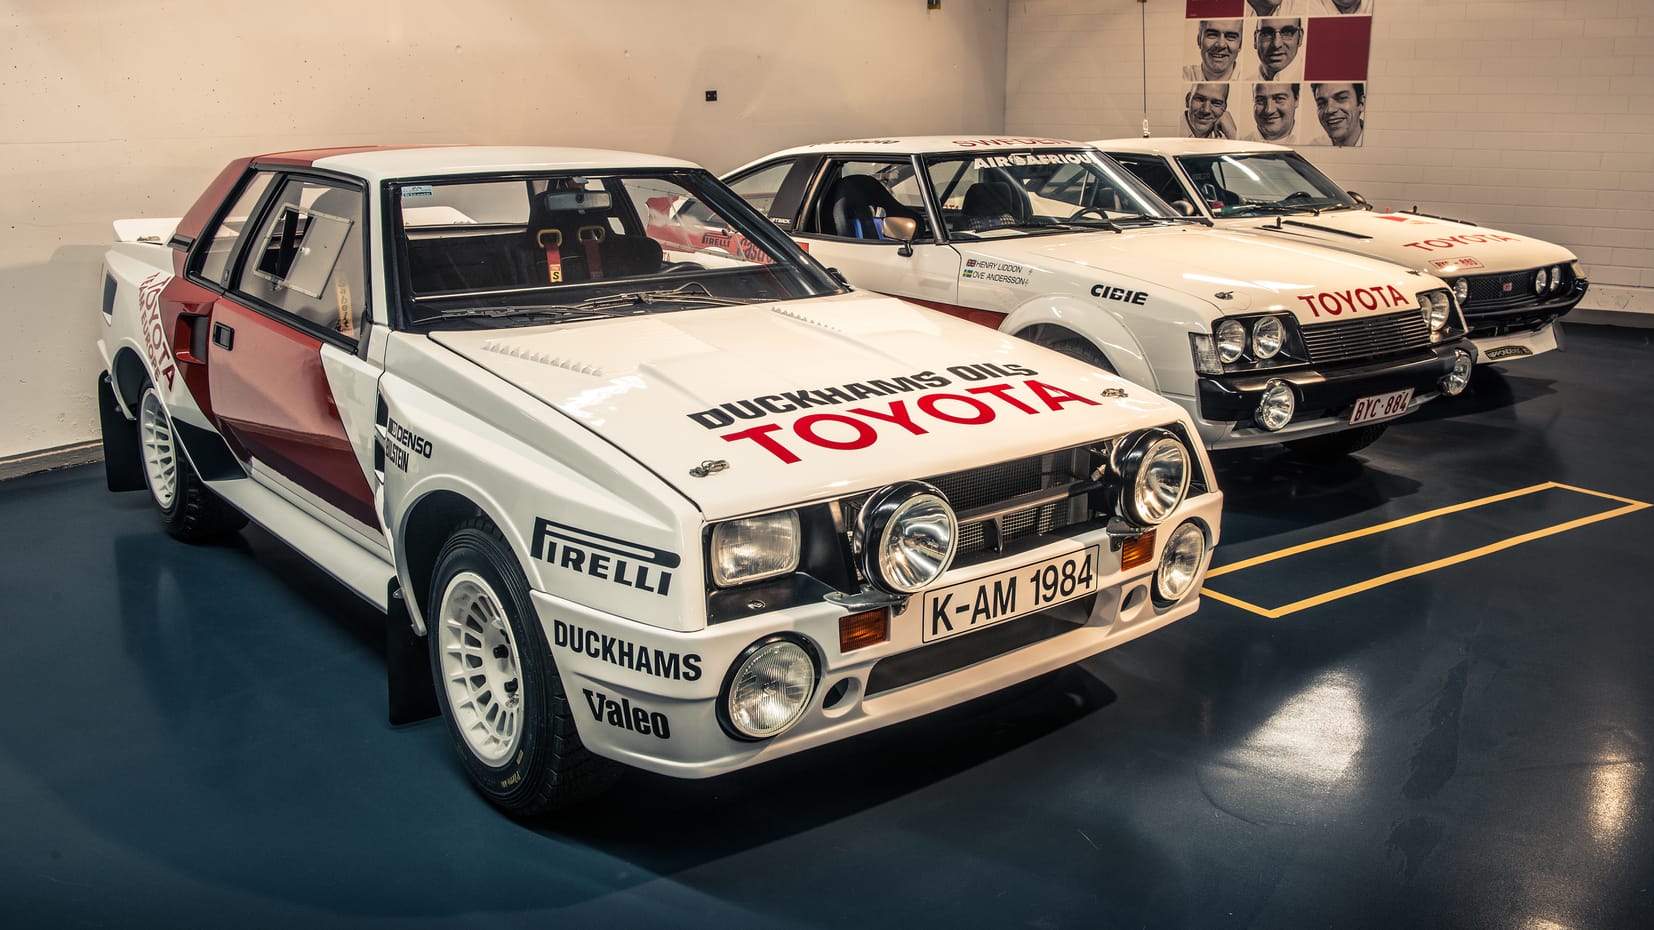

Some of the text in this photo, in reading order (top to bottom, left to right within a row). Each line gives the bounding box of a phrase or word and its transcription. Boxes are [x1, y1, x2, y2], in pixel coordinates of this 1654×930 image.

[974, 156, 1012, 169] AIR
[702, 231, 732, 248] PIRELLI
[1403, 234, 1520, 251] TOYOTA
[552, 271, 560, 280] S
[973, 270, 1025, 285] OVE ANDERSSON
[976, 260, 1022, 273] HENRY LIDDON
[1090, 284, 1149, 306] CIBIE
[1297, 284, 1409, 318] TOYOTA
[141, 311, 160, 382] EUROPE
[146, 276, 175, 393] TOYOTA
[687, 363, 1040, 430] DUCKHAMS OILS
[720, 379, 1104, 464] TOYOTA
[386, 437, 409, 473] BILSTEIN
[397, 425, 432, 459] DENSO
[530, 516, 682, 597] PIRELLI
[932, 554, 1093, 636] K-AM 1984
[553, 619, 703, 682] DUCKHAMS
[582, 688, 671, 740] Valeo
